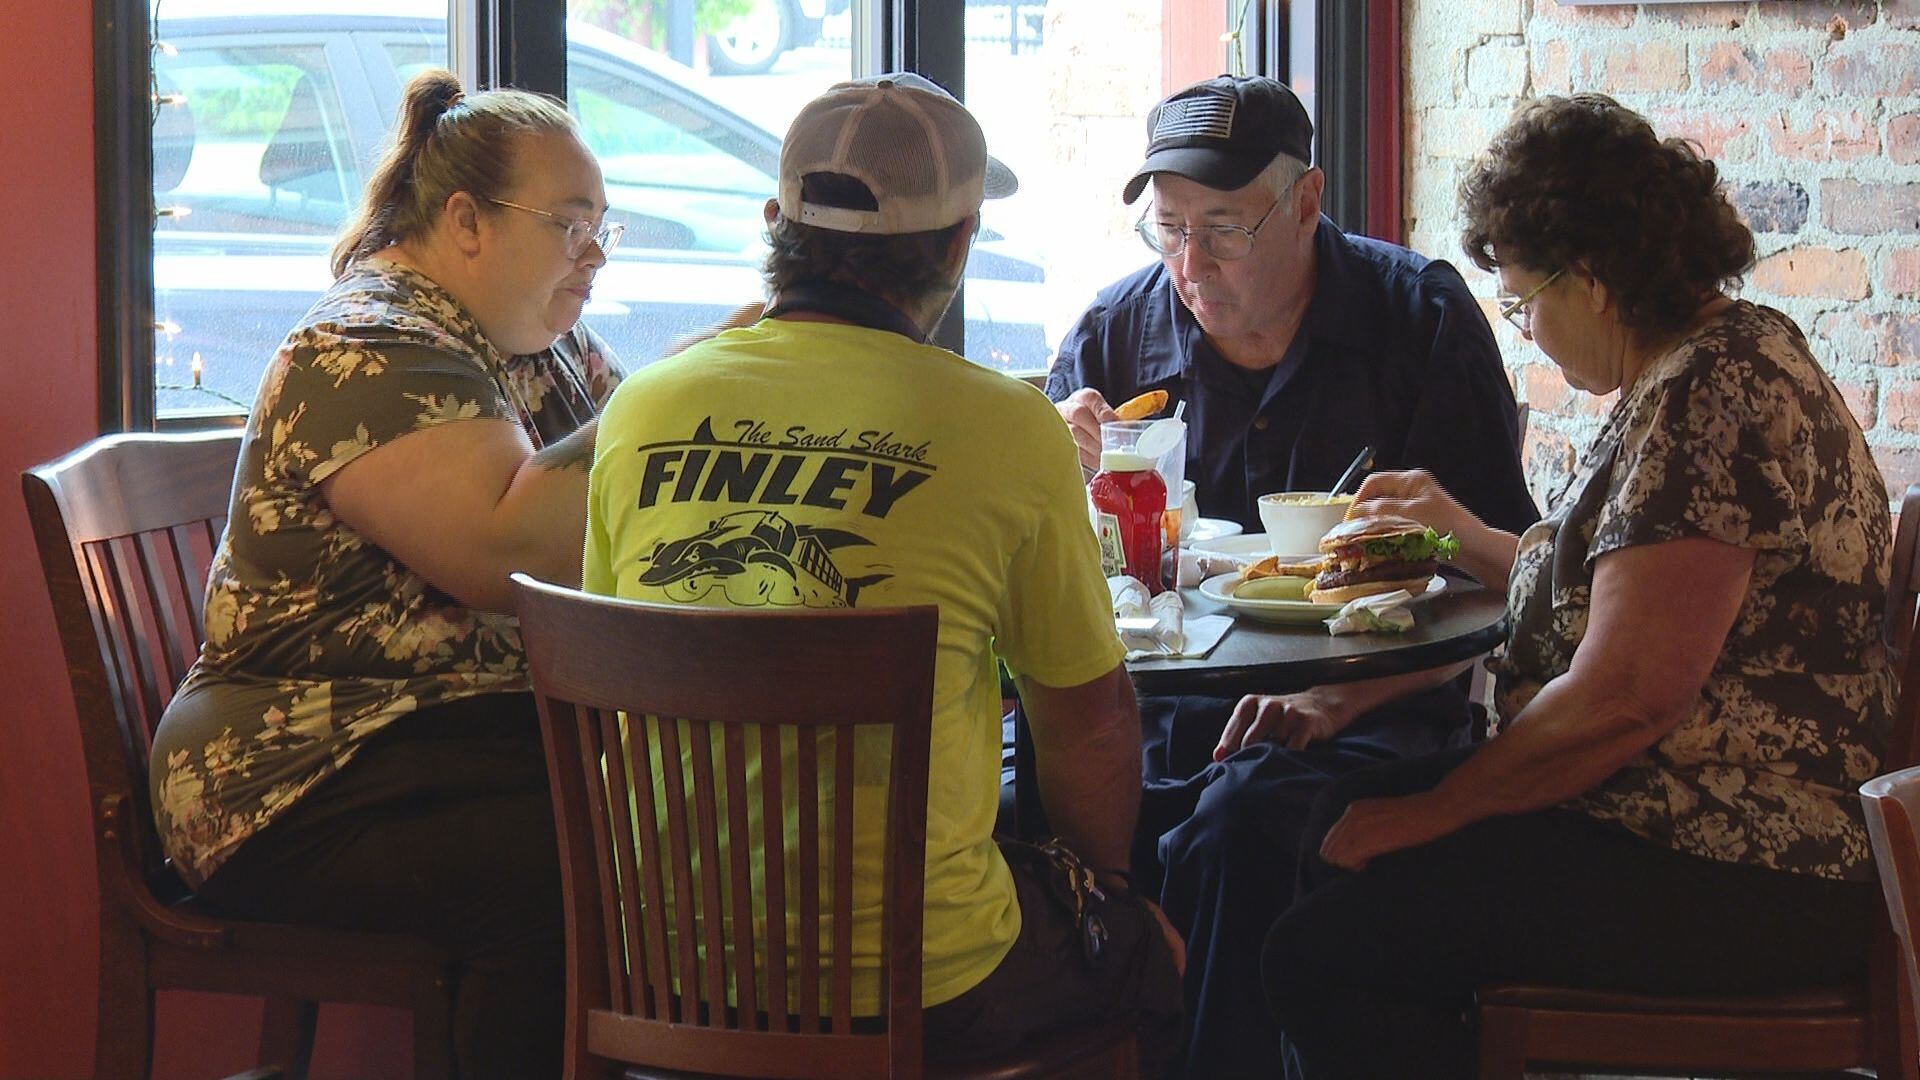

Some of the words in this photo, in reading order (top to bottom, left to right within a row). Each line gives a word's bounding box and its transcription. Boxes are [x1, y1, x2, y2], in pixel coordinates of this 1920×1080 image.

[734, 420, 771, 443] The
[780, 426, 848, 447] Sand
[851, 430, 931, 461] Shark
[638, 449, 931, 519] FINLEY
